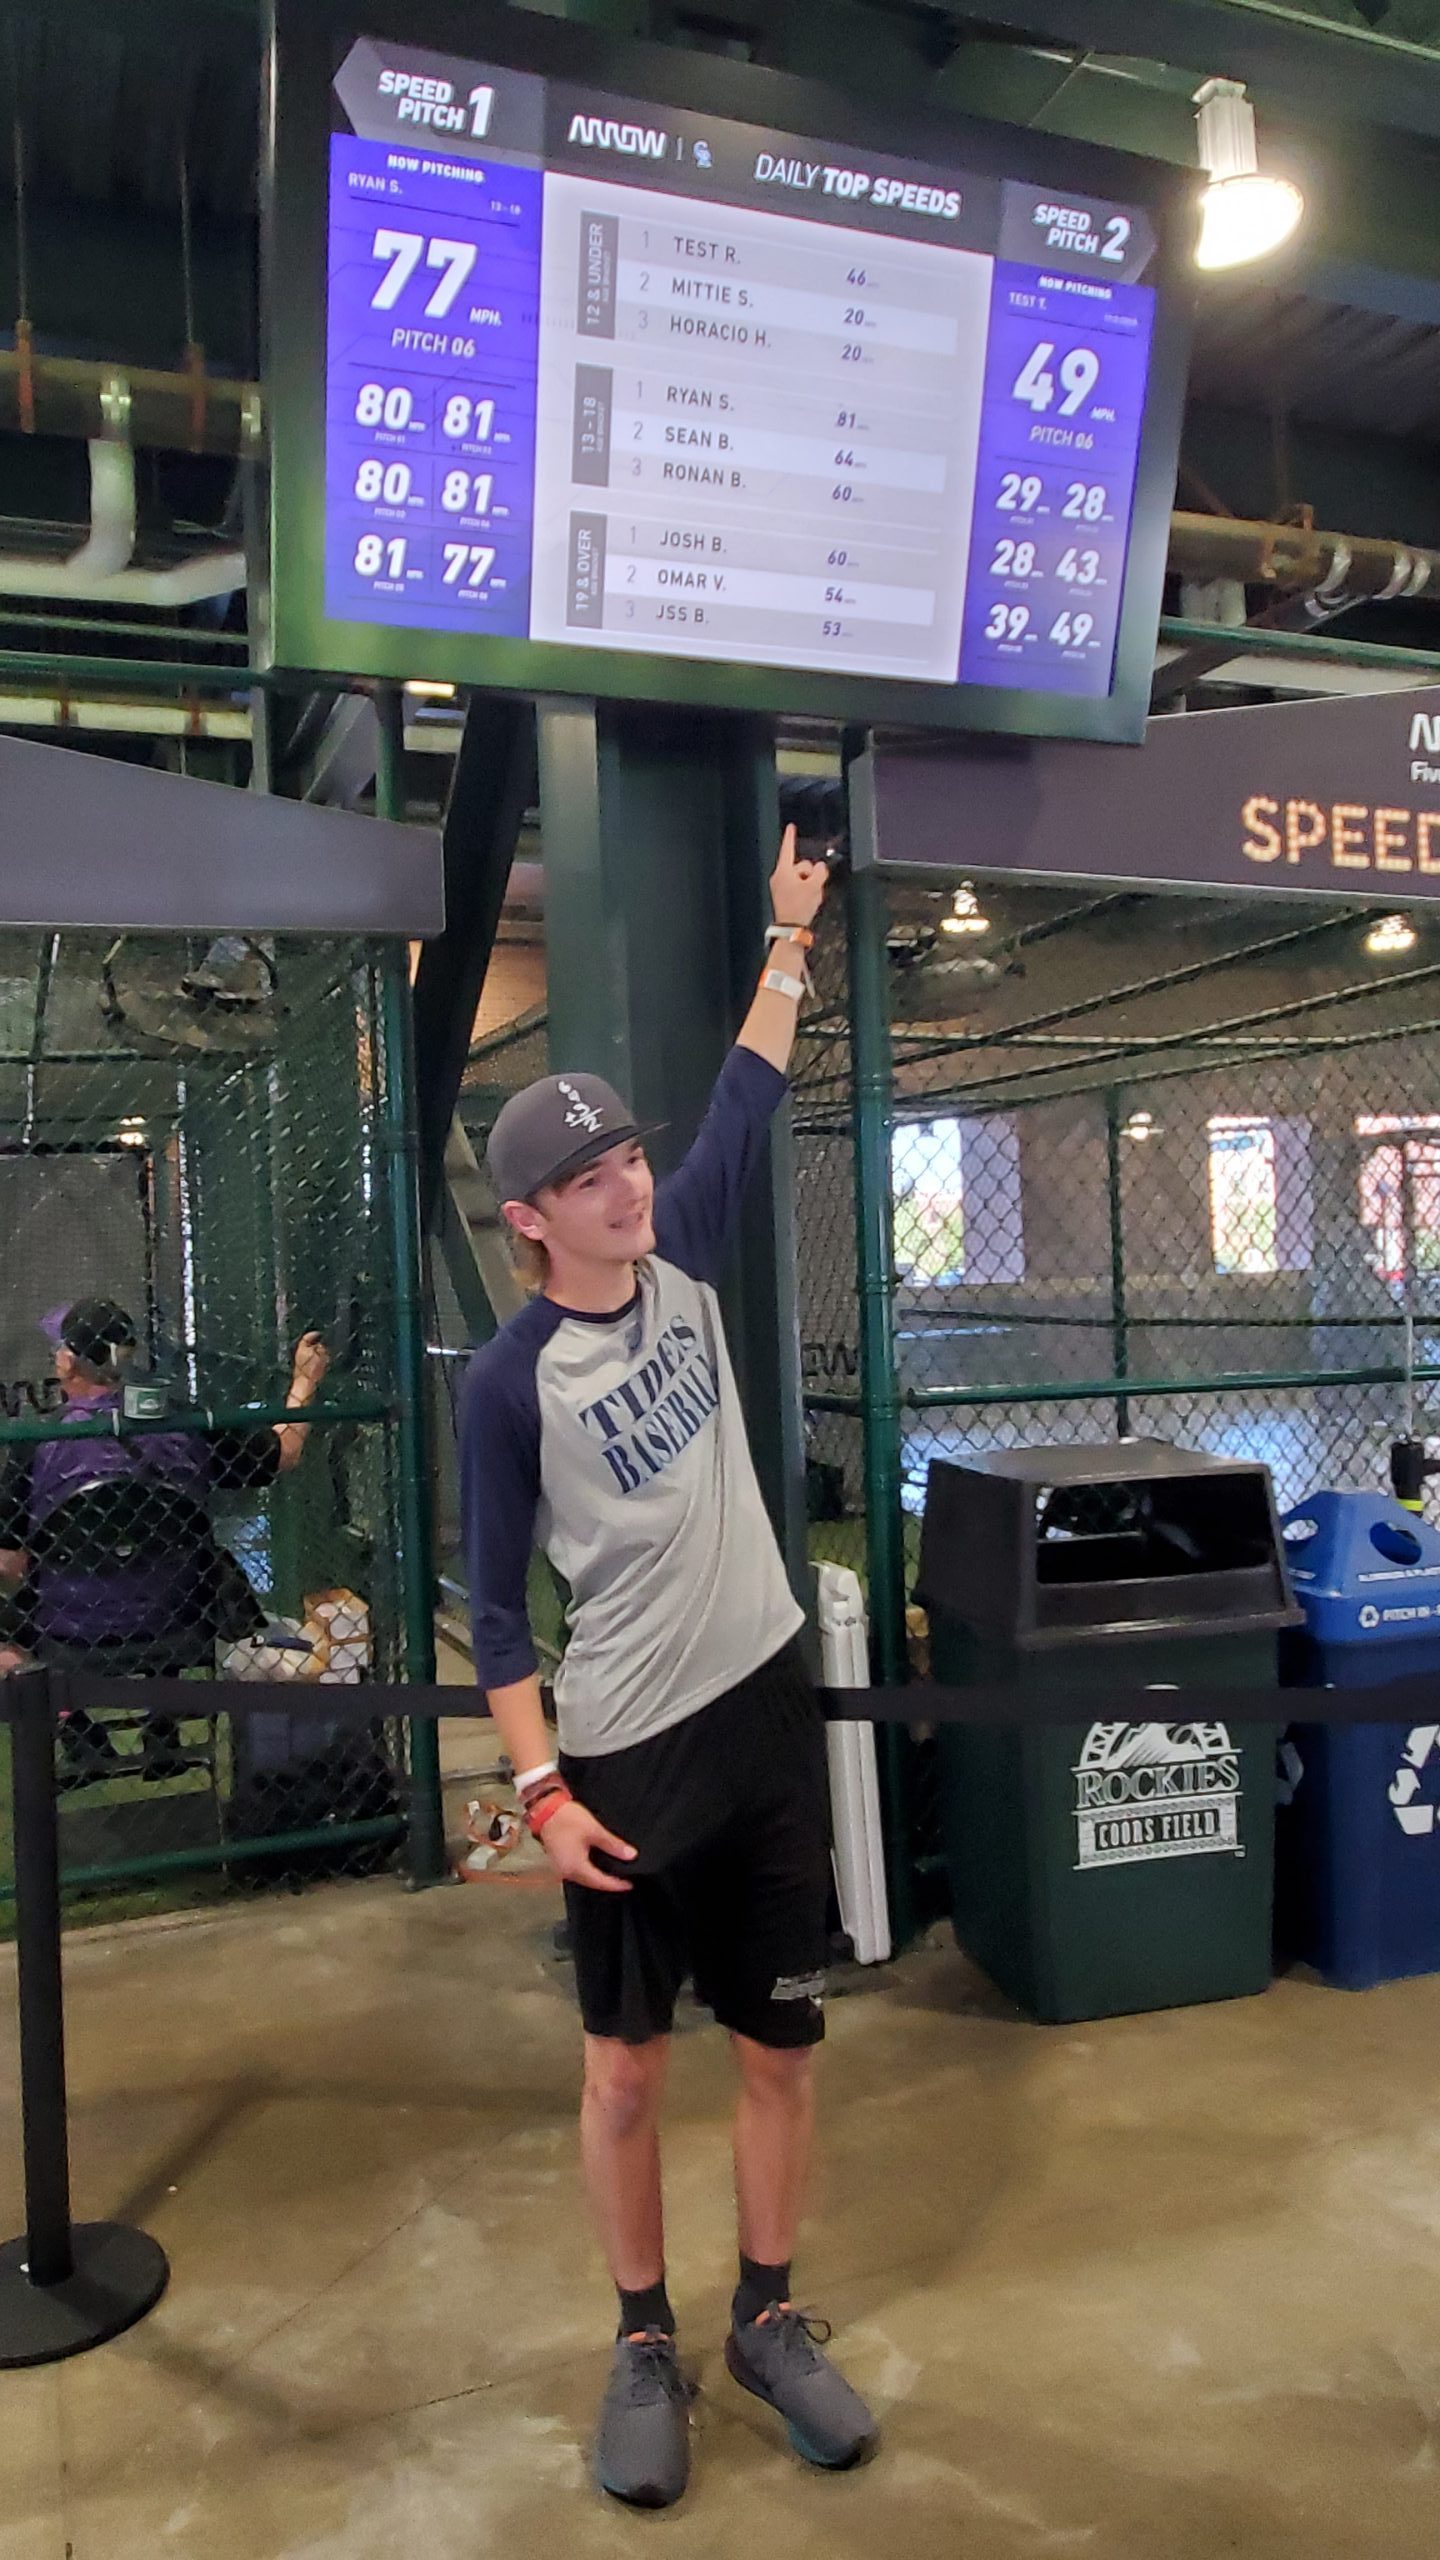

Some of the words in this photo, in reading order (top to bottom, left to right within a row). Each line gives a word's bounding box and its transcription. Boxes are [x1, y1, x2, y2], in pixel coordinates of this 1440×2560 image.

[378, 69, 453, 103] SPEED
[398, 97, 465, 130] PITCH
[468, 85, 495, 137] 1
[349, 172, 385, 192] RYAN
[389, 180, 403, 195] S.
[387, 153, 420, 173] NOW
[422, 161, 485, 183] PITCHING
[754, 152, 820, 189] DAILY
[822, 166, 870, 198] TOP
[870, 177, 962, 219] SPEEDS
[1033, 203, 1091, 231] SPEED
[588, 222, 603, 284] UNDER
[642, 230, 649, 248] 1
[674, 236, 719, 261] TEST
[846, 267, 867, 286] 46
[1046, 227, 1099, 253] PITCH
[1100, 215, 1131, 262] 2
[370, 228, 478, 319] 77
[1038, 274, 1064, 291] NOW
[1065, 280, 1112, 300] PITCHING
[586, 304, 600, 325] 12
[639, 271, 650, 292] 2
[672, 277, 731, 304] MITTIE
[843, 307, 865, 326] 20
[1009, 291, 1036, 308] TEST
[391, 328, 448, 355] PITCH
[450, 336, 476, 358] 06
[638, 309, 648, 330] 3
[670, 315, 748, 344] HORACIO
[841, 343, 862, 361] 20
[1013, 342, 1100, 417] 49
[355, 383, 413, 431] 80
[442, 395, 496, 441] 81
[637, 380, 643, 399] 1
[667, 385, 712, 408] RYAN
[835, 411, 856, 429] 81
[581, 433, 596, 454] 13
[633, 420, 644, 441] 2
[665, 425, 712, 448] SEAN
[834, 449, 854, 467] 64
[1029, 425, 1073, 446] PITCH
[354, 459, 411, 506] 80
[441, 470, 493, 515] 81
[632, 457, 642, 478] 3
[663, 461, 724, 486] RONAN
[832, 484, 852, 502] 60
[995, 473, 1042, 512] 29
[1061, 482, 1106, 521] 28
[354, 534, 407, 579] 81
[442, 542, 496, 587] 77
[577, 528, 593, 573] OVER
[630, 525, 636, 545] 1
[659, 530, 704, 551] JOSH
[827, 550, 847, 567] 60
[989, 539, 1036, 577] 28
[626, 564, 637, 584] 2
[657, 568, 707, 590] OMAR
[824, 586, 844, 603] 54
[1055, 548, 1100, 585] 43
[575, 592, 590, 611] 19
[625, 600, 635, 618] 3
[655, 604, 688, 622] JSS
[822, 620, 842, 636] 53
[984, 603, 1030, 640] 39
[1049, 611, 1093, 646] 49
[578, 1314, 697, 1443] TIDES
[1075, 1755, 1240, 1810] ROCKIES
[1099, 1817, 1155, 1848] COORS
[1161, 1811, 1216, 1840] FIELD
